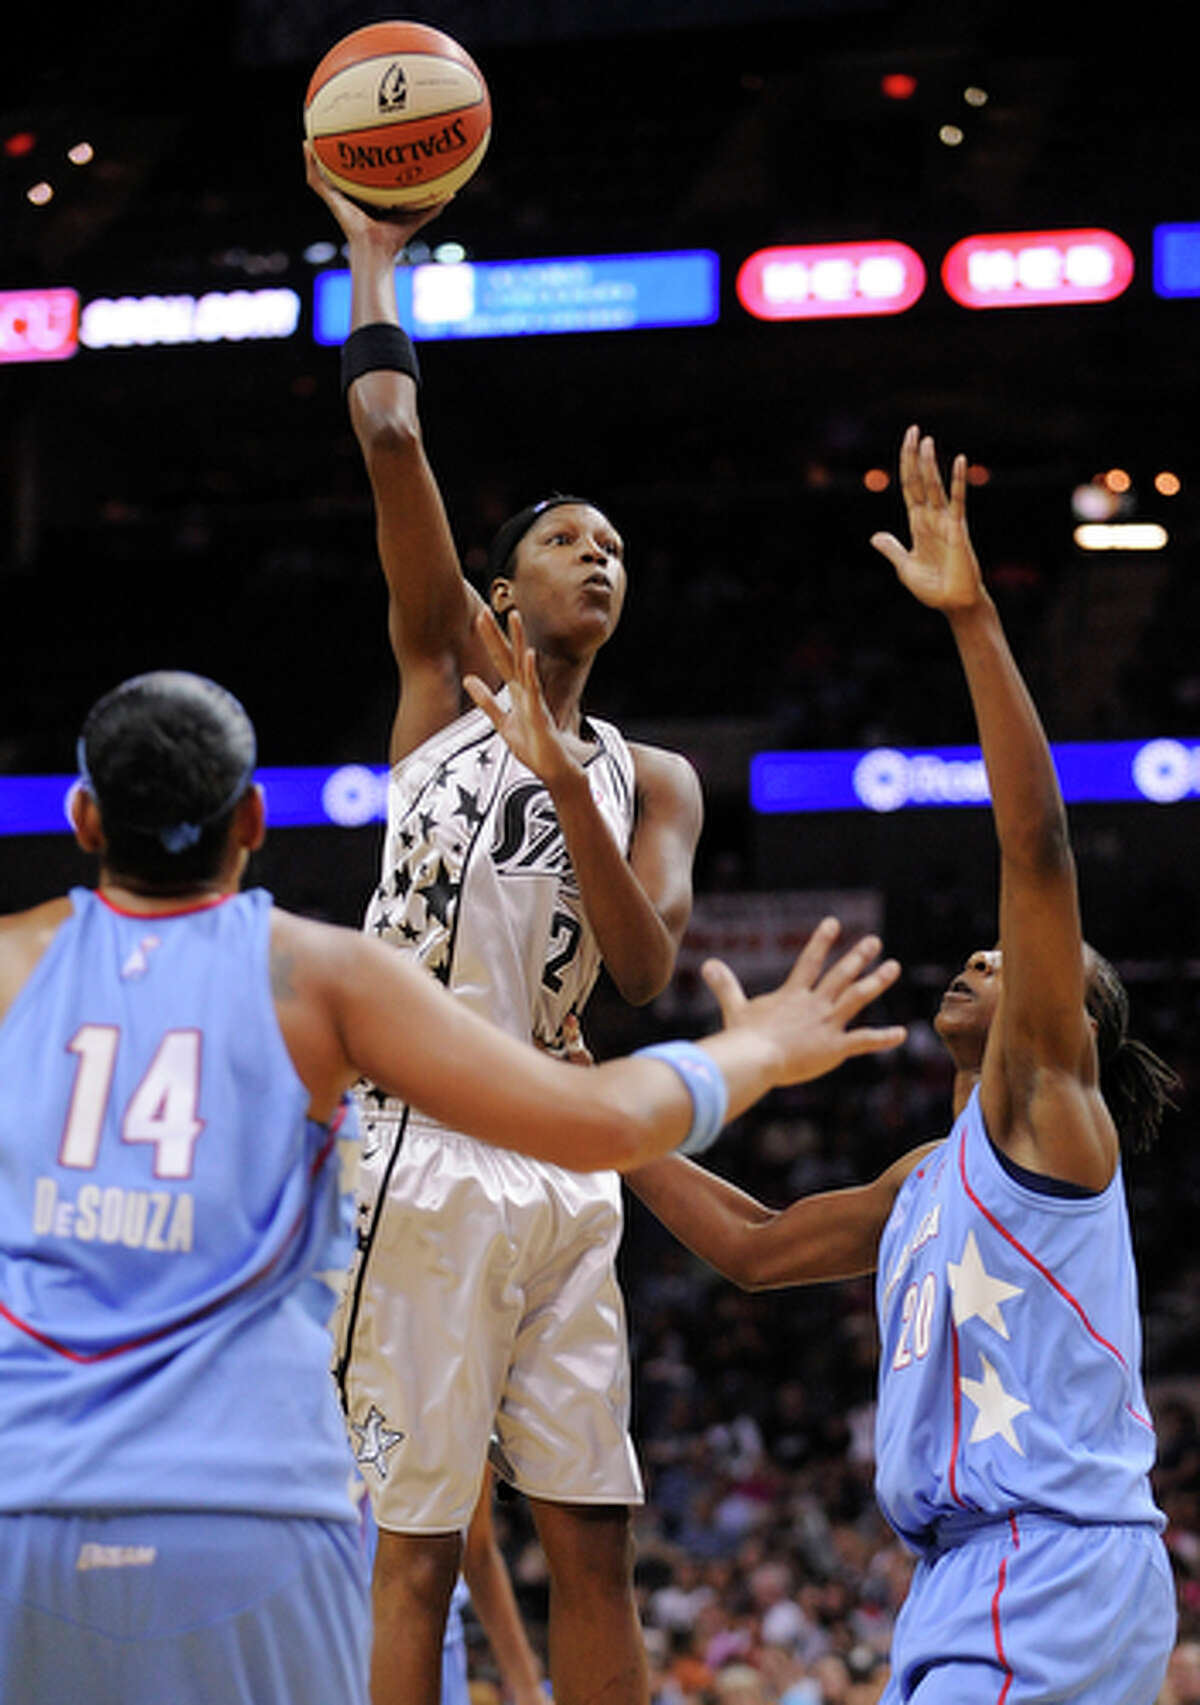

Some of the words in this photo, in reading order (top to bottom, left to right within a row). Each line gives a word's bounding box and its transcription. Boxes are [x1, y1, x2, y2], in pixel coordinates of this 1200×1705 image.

[337, 118, 467, 169] SPALDING
[542, 911, 583, 993] 2
[58, 1022, 206, 1180] 14
[892, 1271, 937, 1372] 20
